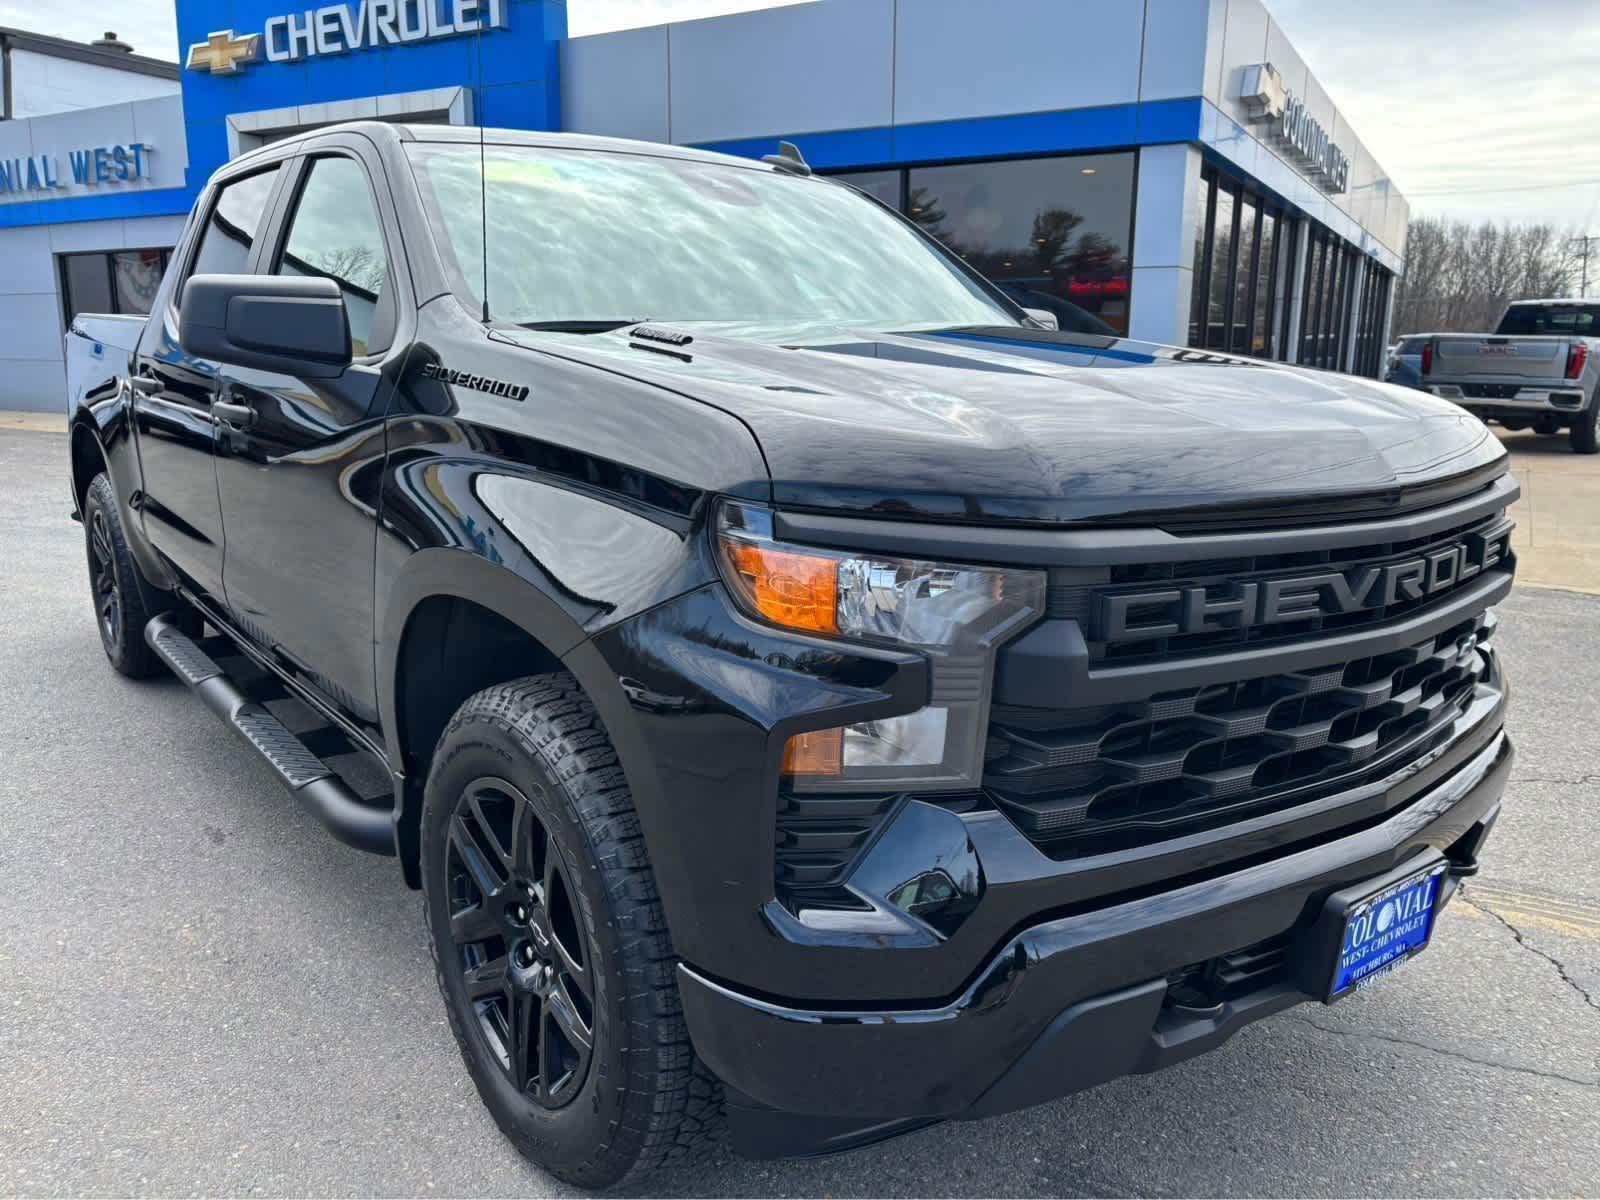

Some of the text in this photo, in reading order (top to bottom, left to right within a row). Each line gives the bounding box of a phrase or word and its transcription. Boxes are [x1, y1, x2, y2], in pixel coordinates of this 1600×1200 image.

[265, 0, 502, 62] CHEVROLET
[68, 143, 145, 185] WEST
[421, 362, 530, 402] SILVERADO
